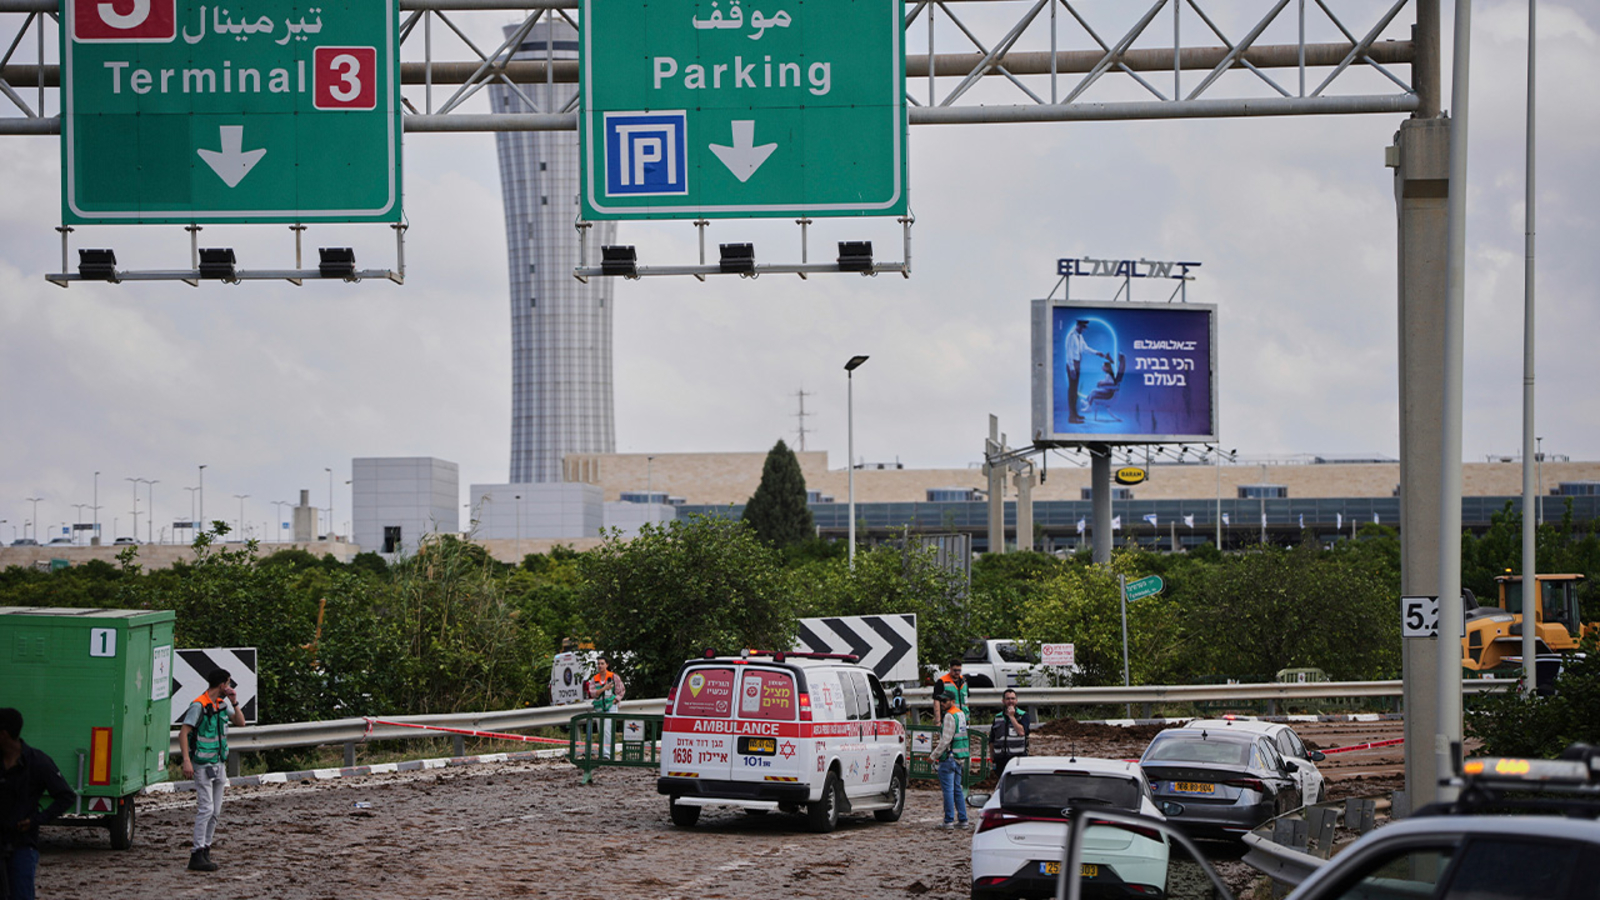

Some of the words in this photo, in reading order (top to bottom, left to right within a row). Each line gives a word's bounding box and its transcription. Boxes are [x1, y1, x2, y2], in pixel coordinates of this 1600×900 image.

[182, 5, 323, 45] تيرمينال
[692, 0, 792, 40] موقف
[104, 60, 306, 94] Terminal
[329, 54, 362, 102] 3
[653, 55, 831, 96] Parking
[1135, 357, 1170, 371] בבית
[1172, 357, 1195, 371] הכי
[1143, 372, 1186, 387] בעולם
[100, 631, 107, 653] 1
[558, 689, 578, 698] TOYOTA
[706, 687, 729, 695] עכשיו
[764, 686, 790, 697] מציל
[763, 698, 789, 707] חיים
[693, 719, 780, 736] AMBULANCE
[676, 738, 694, 747] אדום
[696, 739, 709, 747] דוד
[711, 739, 724, 749] מגן
[672, 748, 693, 764] 1636
[698, 751, 728, 765] איילון
[743, 756, 763, 767] 101
